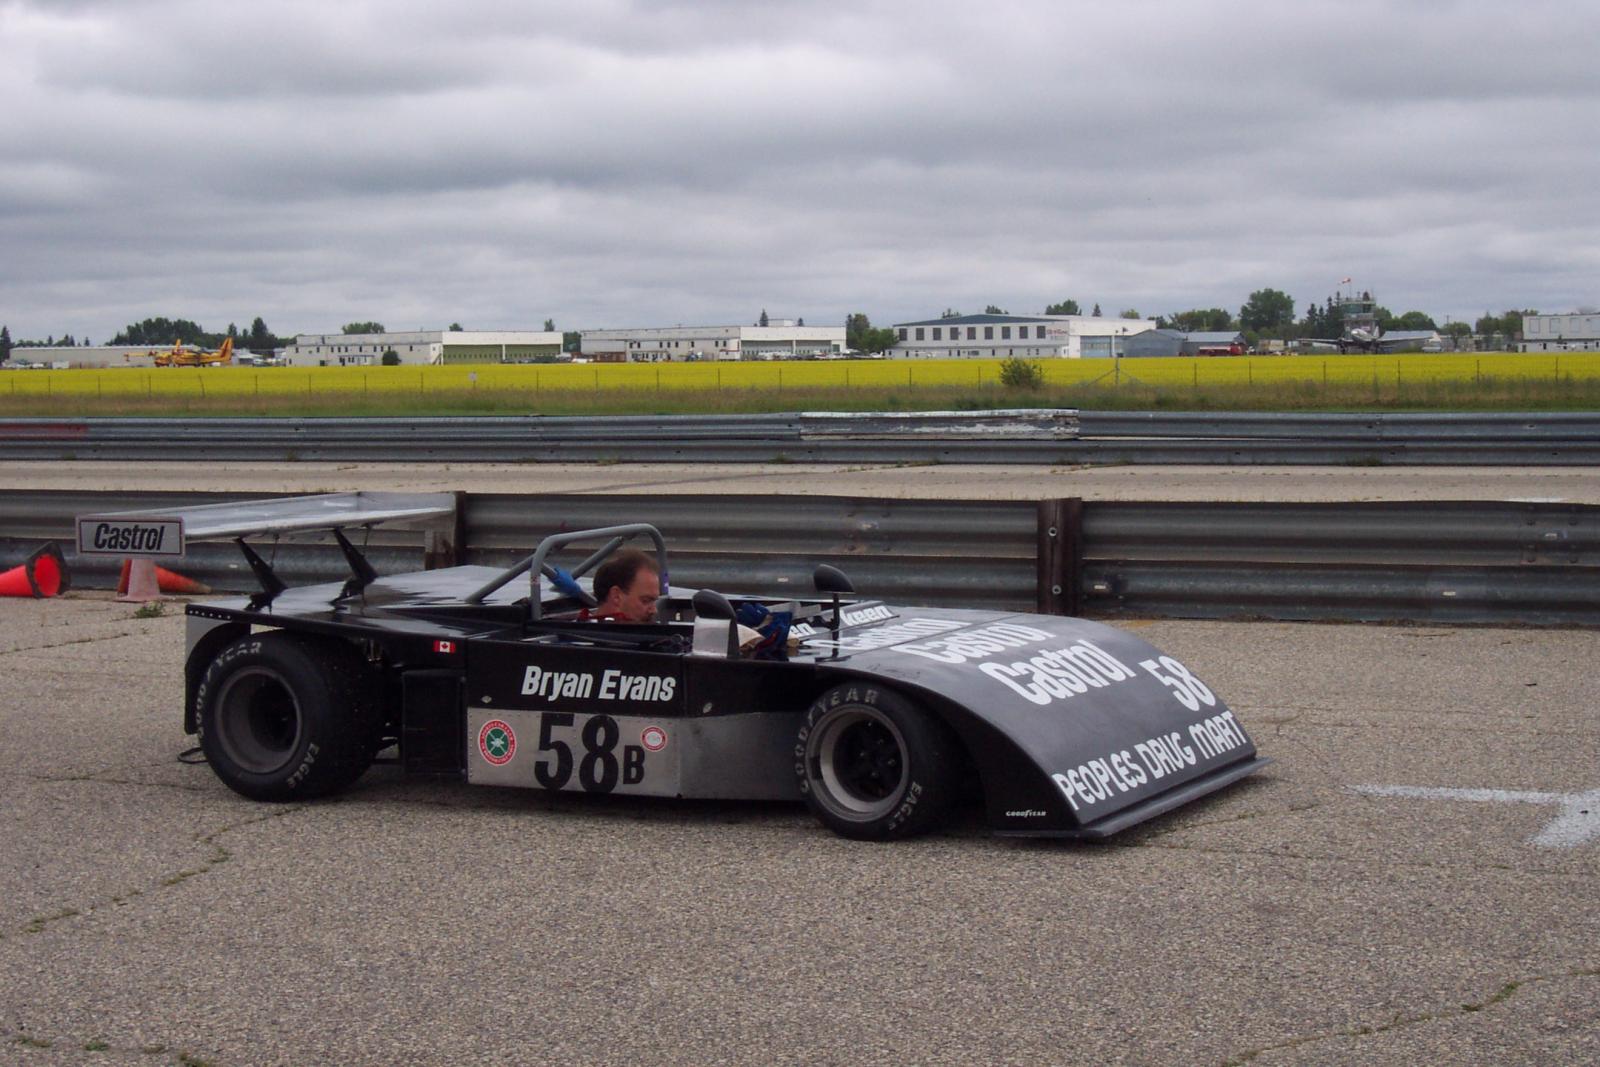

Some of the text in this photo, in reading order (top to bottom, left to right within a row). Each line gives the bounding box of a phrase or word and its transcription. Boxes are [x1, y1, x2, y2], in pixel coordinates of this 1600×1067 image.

[94, 522, 165, 551] Castrol
[889, 622, 1057, 664] Castrol
[521, 665, 676, 701] Bryan Evans
[978, 638, 1137, 706] Castrol
[1138, 655, 1216, 712] 58
[1052, 710, 1247, 811] PEOPLES DRUG MART
